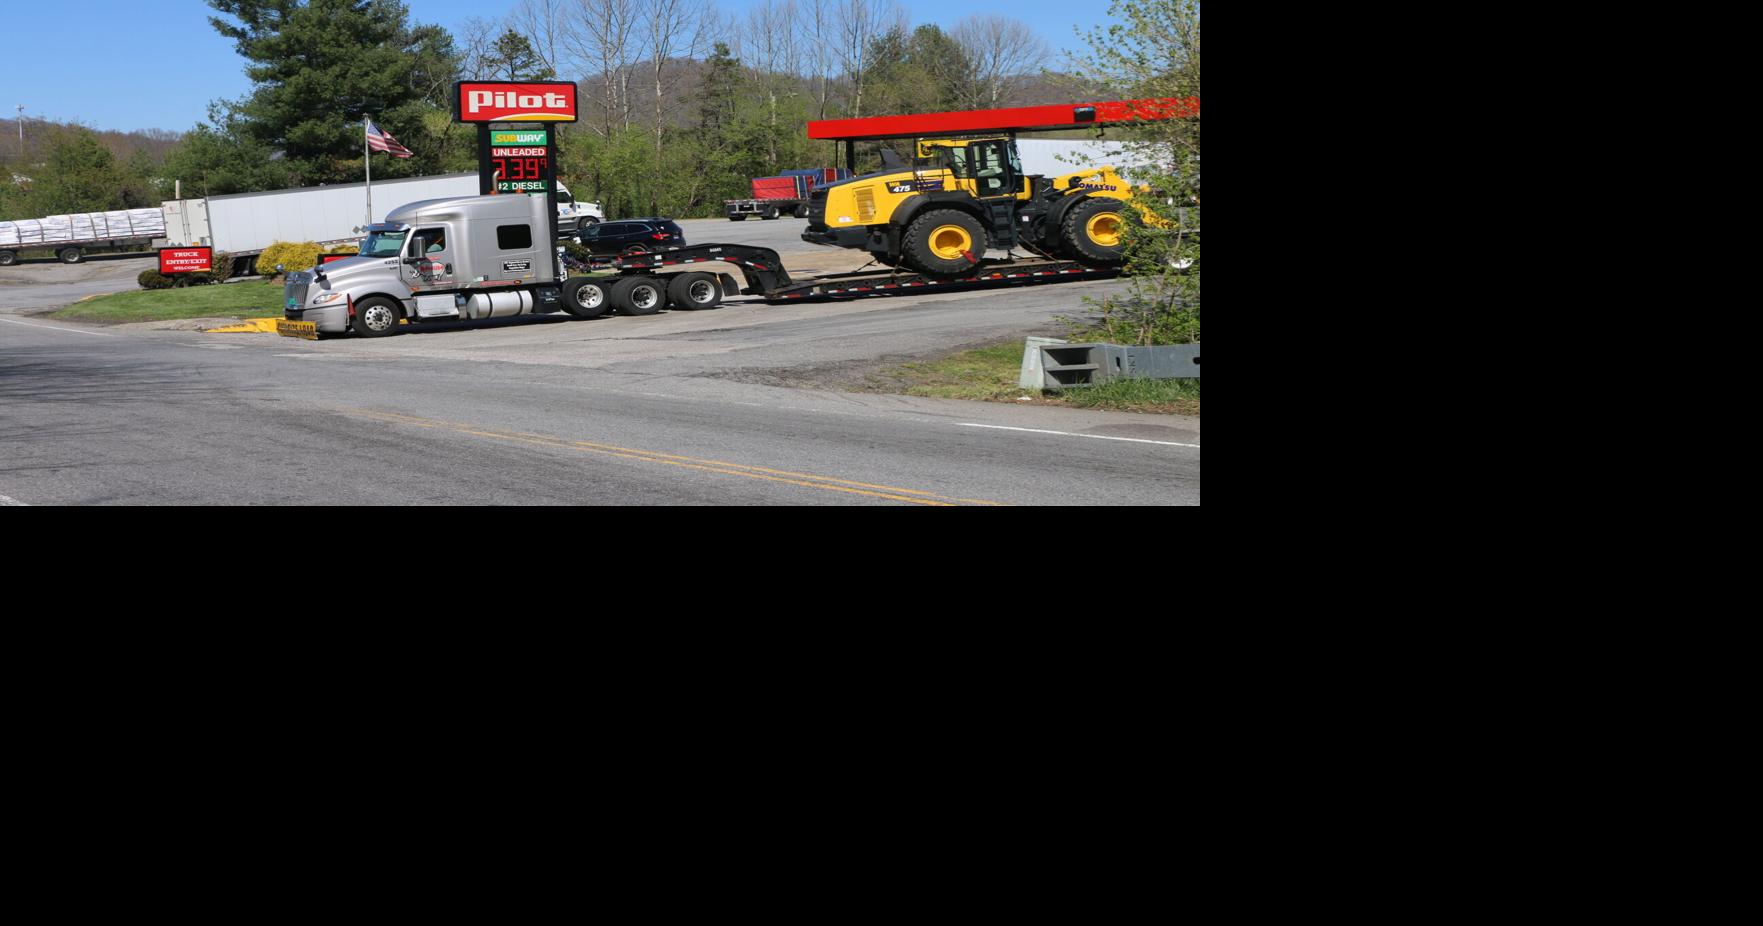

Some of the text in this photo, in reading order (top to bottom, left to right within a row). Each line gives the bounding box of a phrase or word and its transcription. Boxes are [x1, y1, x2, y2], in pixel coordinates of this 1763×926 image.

[468, 90, 566, 113] Pilot
[495, 134, 544, 143] SUBWAY
[493, 148, 545, 157] UNLEADED
[512, 181, 545, 190] DIESEL
[893, 184, 910, 192] 475
[1079, 182, 1117, 191] OMATSU
